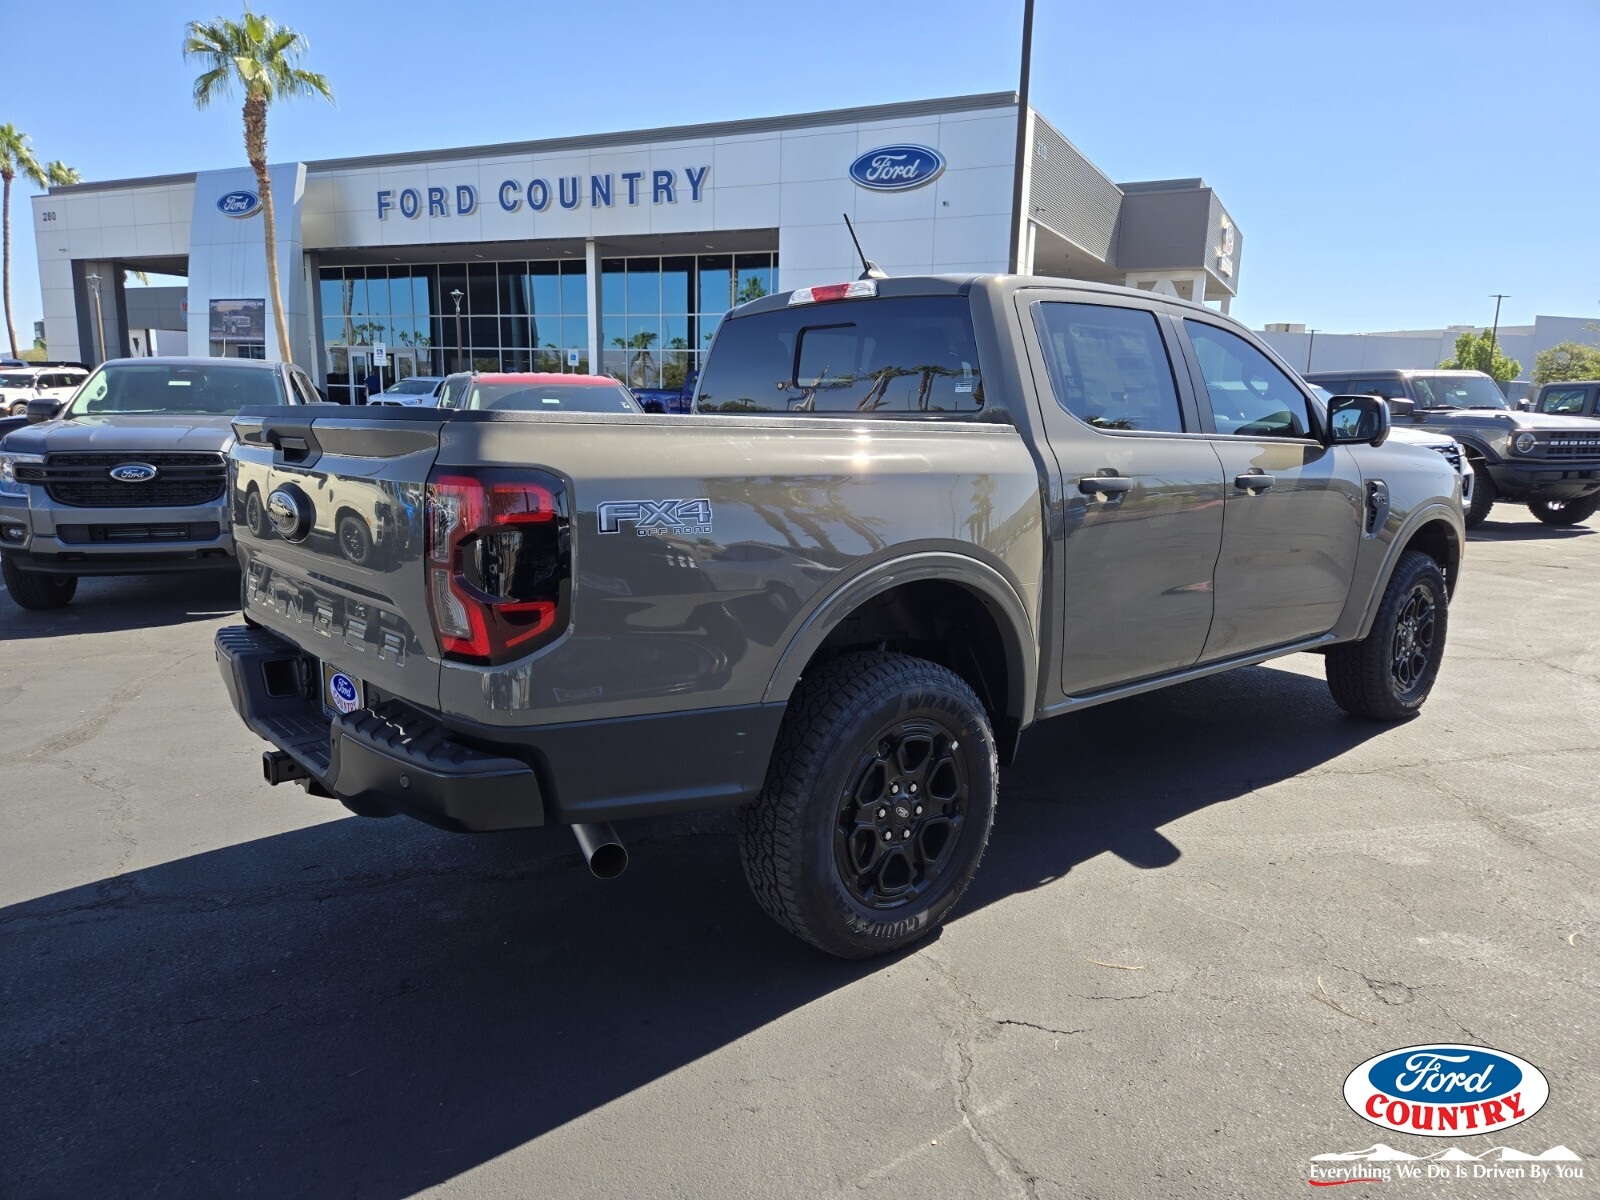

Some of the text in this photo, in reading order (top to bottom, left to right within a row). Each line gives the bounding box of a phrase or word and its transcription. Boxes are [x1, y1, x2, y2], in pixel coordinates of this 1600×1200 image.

[866, 154, 920, 180] Ford
[223, 195, 250, 211] Ford
[377, 166, 708, 220] FORD COUNTRY
[42, 211, 57, 222] 280
[596, 498, 712, 534] FX4
[637, 525, 712, 537] OFF ROAD
[247, 573, 405, 668] RANGER
[337, 677, 352, 698] Ford
